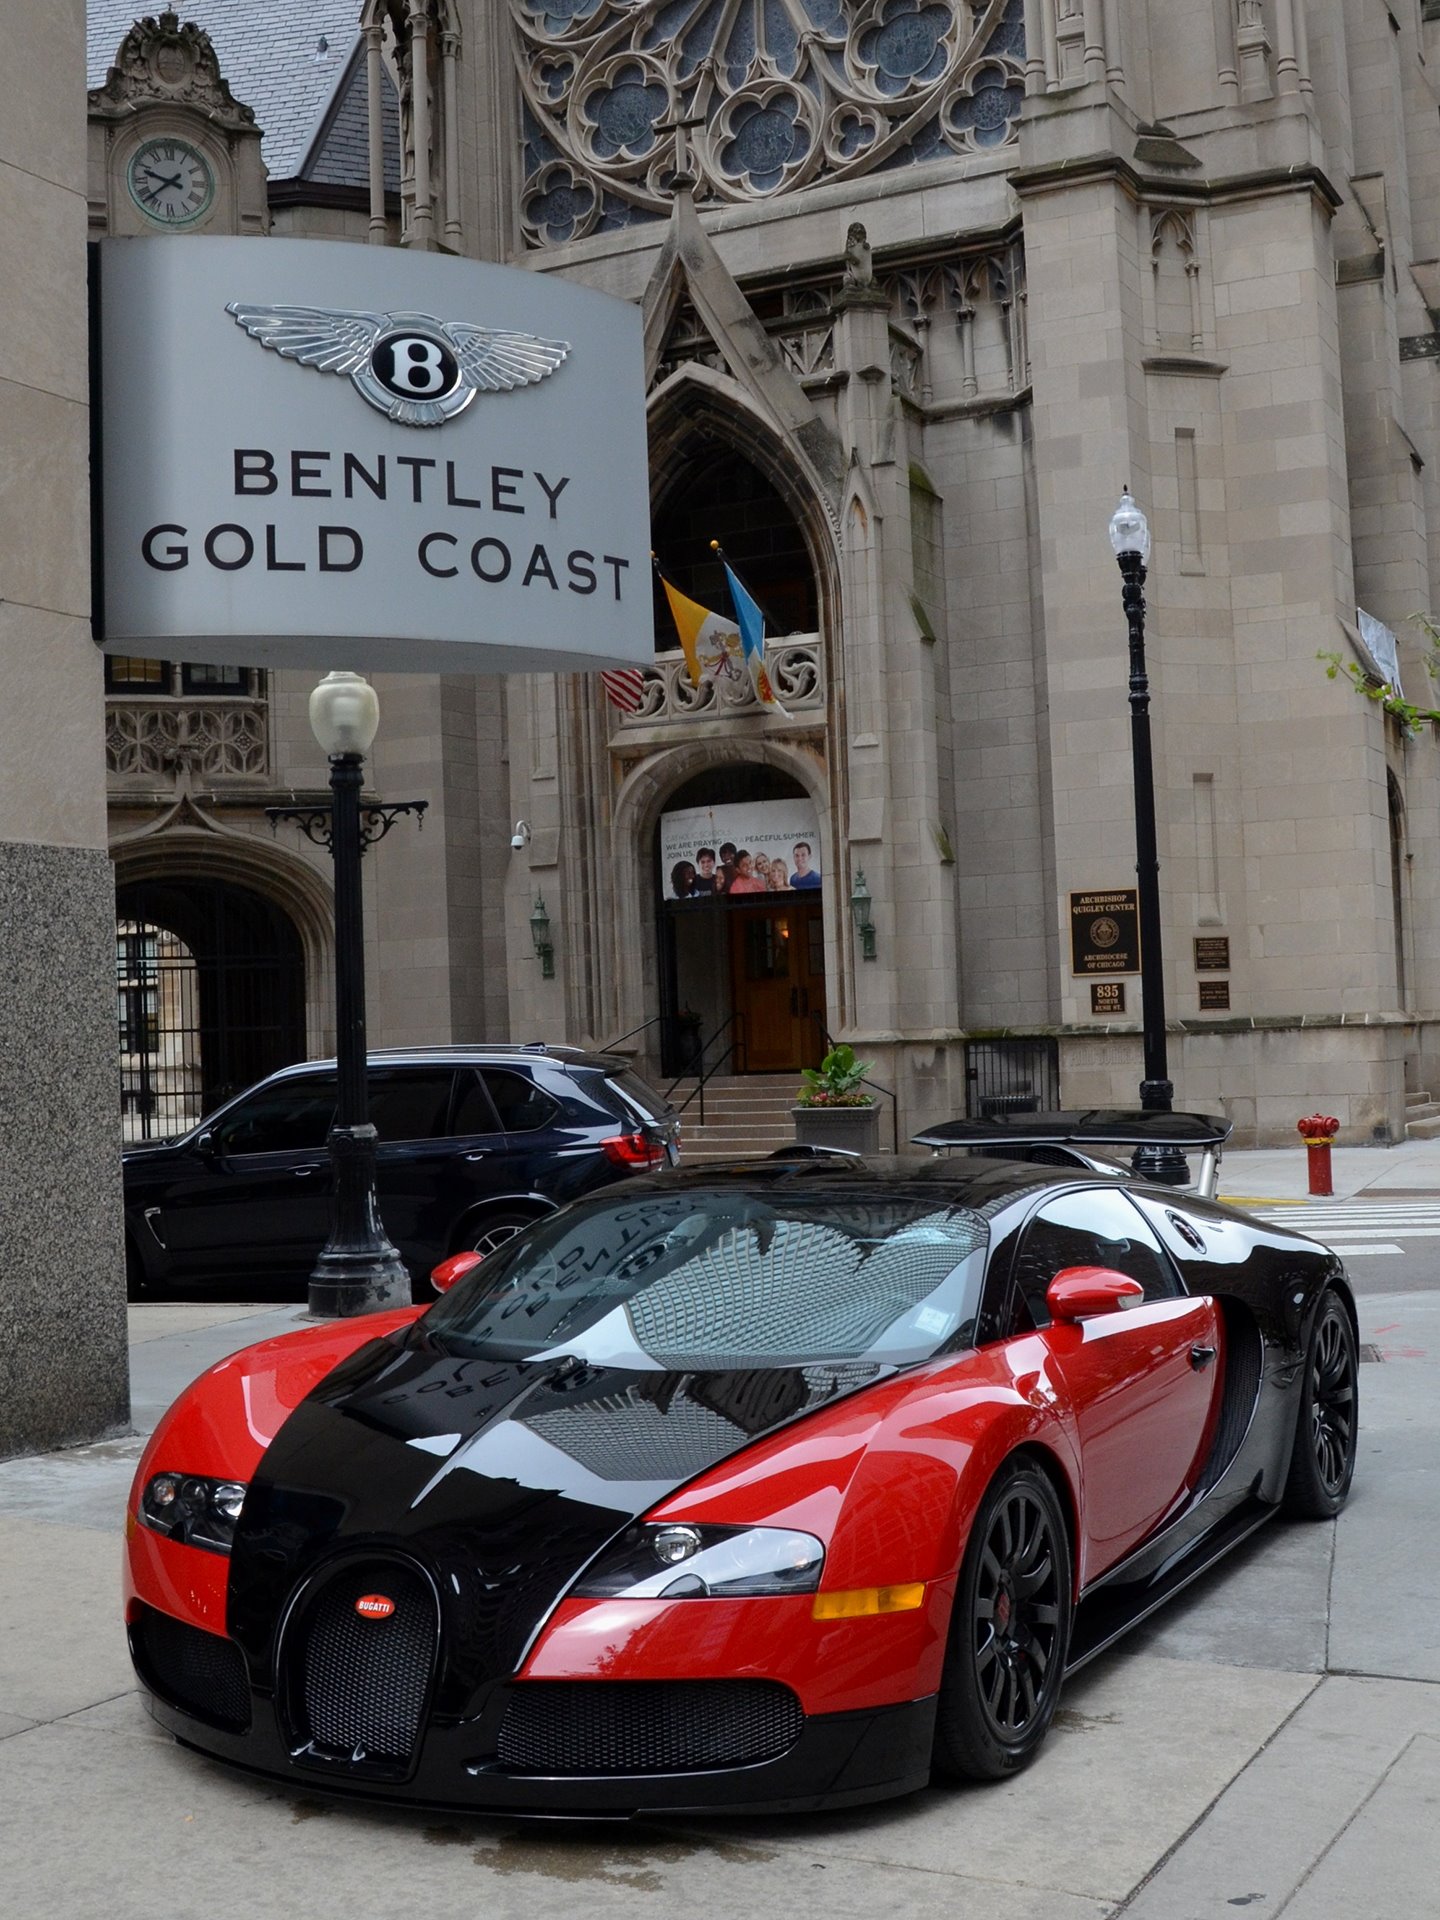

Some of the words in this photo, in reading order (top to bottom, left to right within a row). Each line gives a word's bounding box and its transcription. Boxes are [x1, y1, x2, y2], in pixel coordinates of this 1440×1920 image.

[390, 339, 444, 393] B
[234, 448, 571, 519] BENTLEY
[141, 523, 364, 572] GOLD
[418, 532, 630, 600] COAST
[665, 843, 678, 851] WE
[678, 841, 692, 849] ARE
[745, 834, 783, 842] PEACEFUL
[1080, 895, 1127, 904] ARCHBISHOP
[1073, 904, 1105, 914] QUIGLEY
[1106, 903, 1135, 912] CENTER
[1097, 960, 1125, 968] CHICAGO
[1096, 985, 1119, 998] 835
[358, 1601, 390, 1612] BUGATTI
